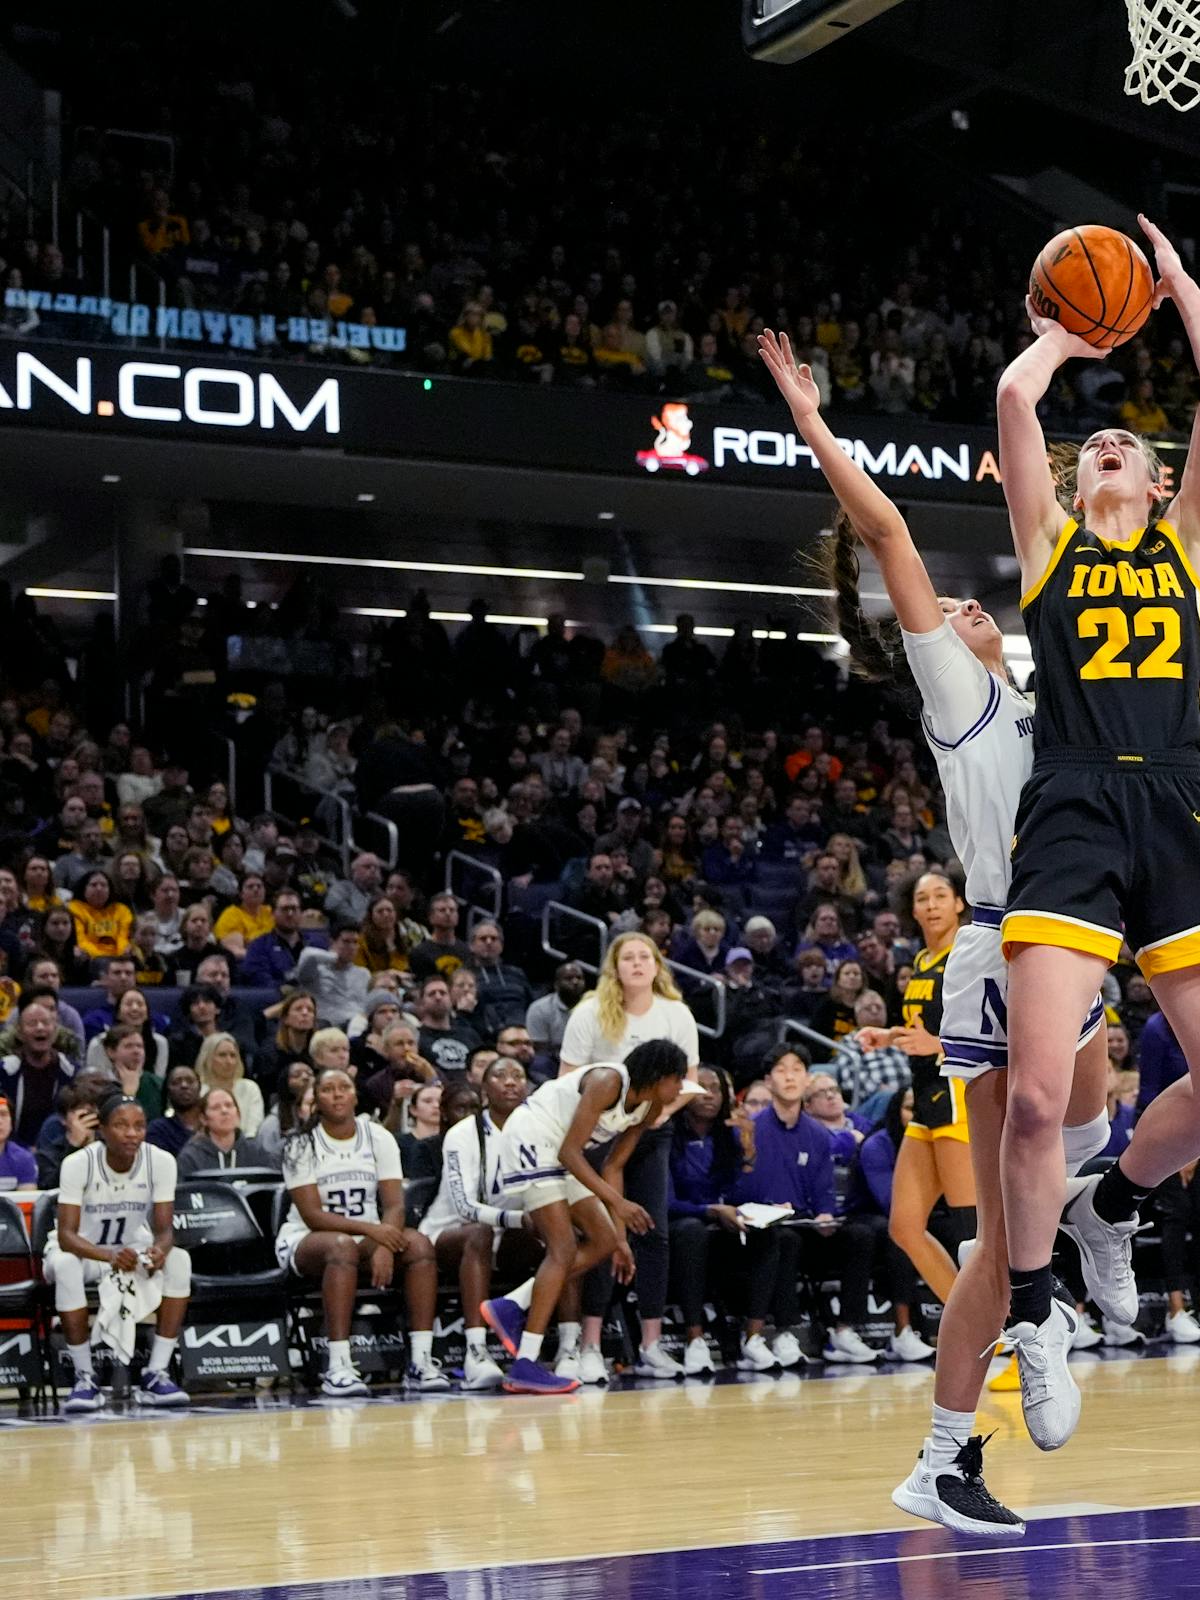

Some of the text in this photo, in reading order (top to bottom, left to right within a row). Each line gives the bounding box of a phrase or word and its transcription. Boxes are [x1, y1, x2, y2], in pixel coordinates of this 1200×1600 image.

[0, 351, 341, 434] N.COM
[1066, 560, 1185, 599] IOWA
[1077, 606, 1184, 680] 22
[519, 1144, 538, 1169] N
[96, 1217, 127, 1245] 11
[223, 1356, 271, 1366] ROHRMAN
